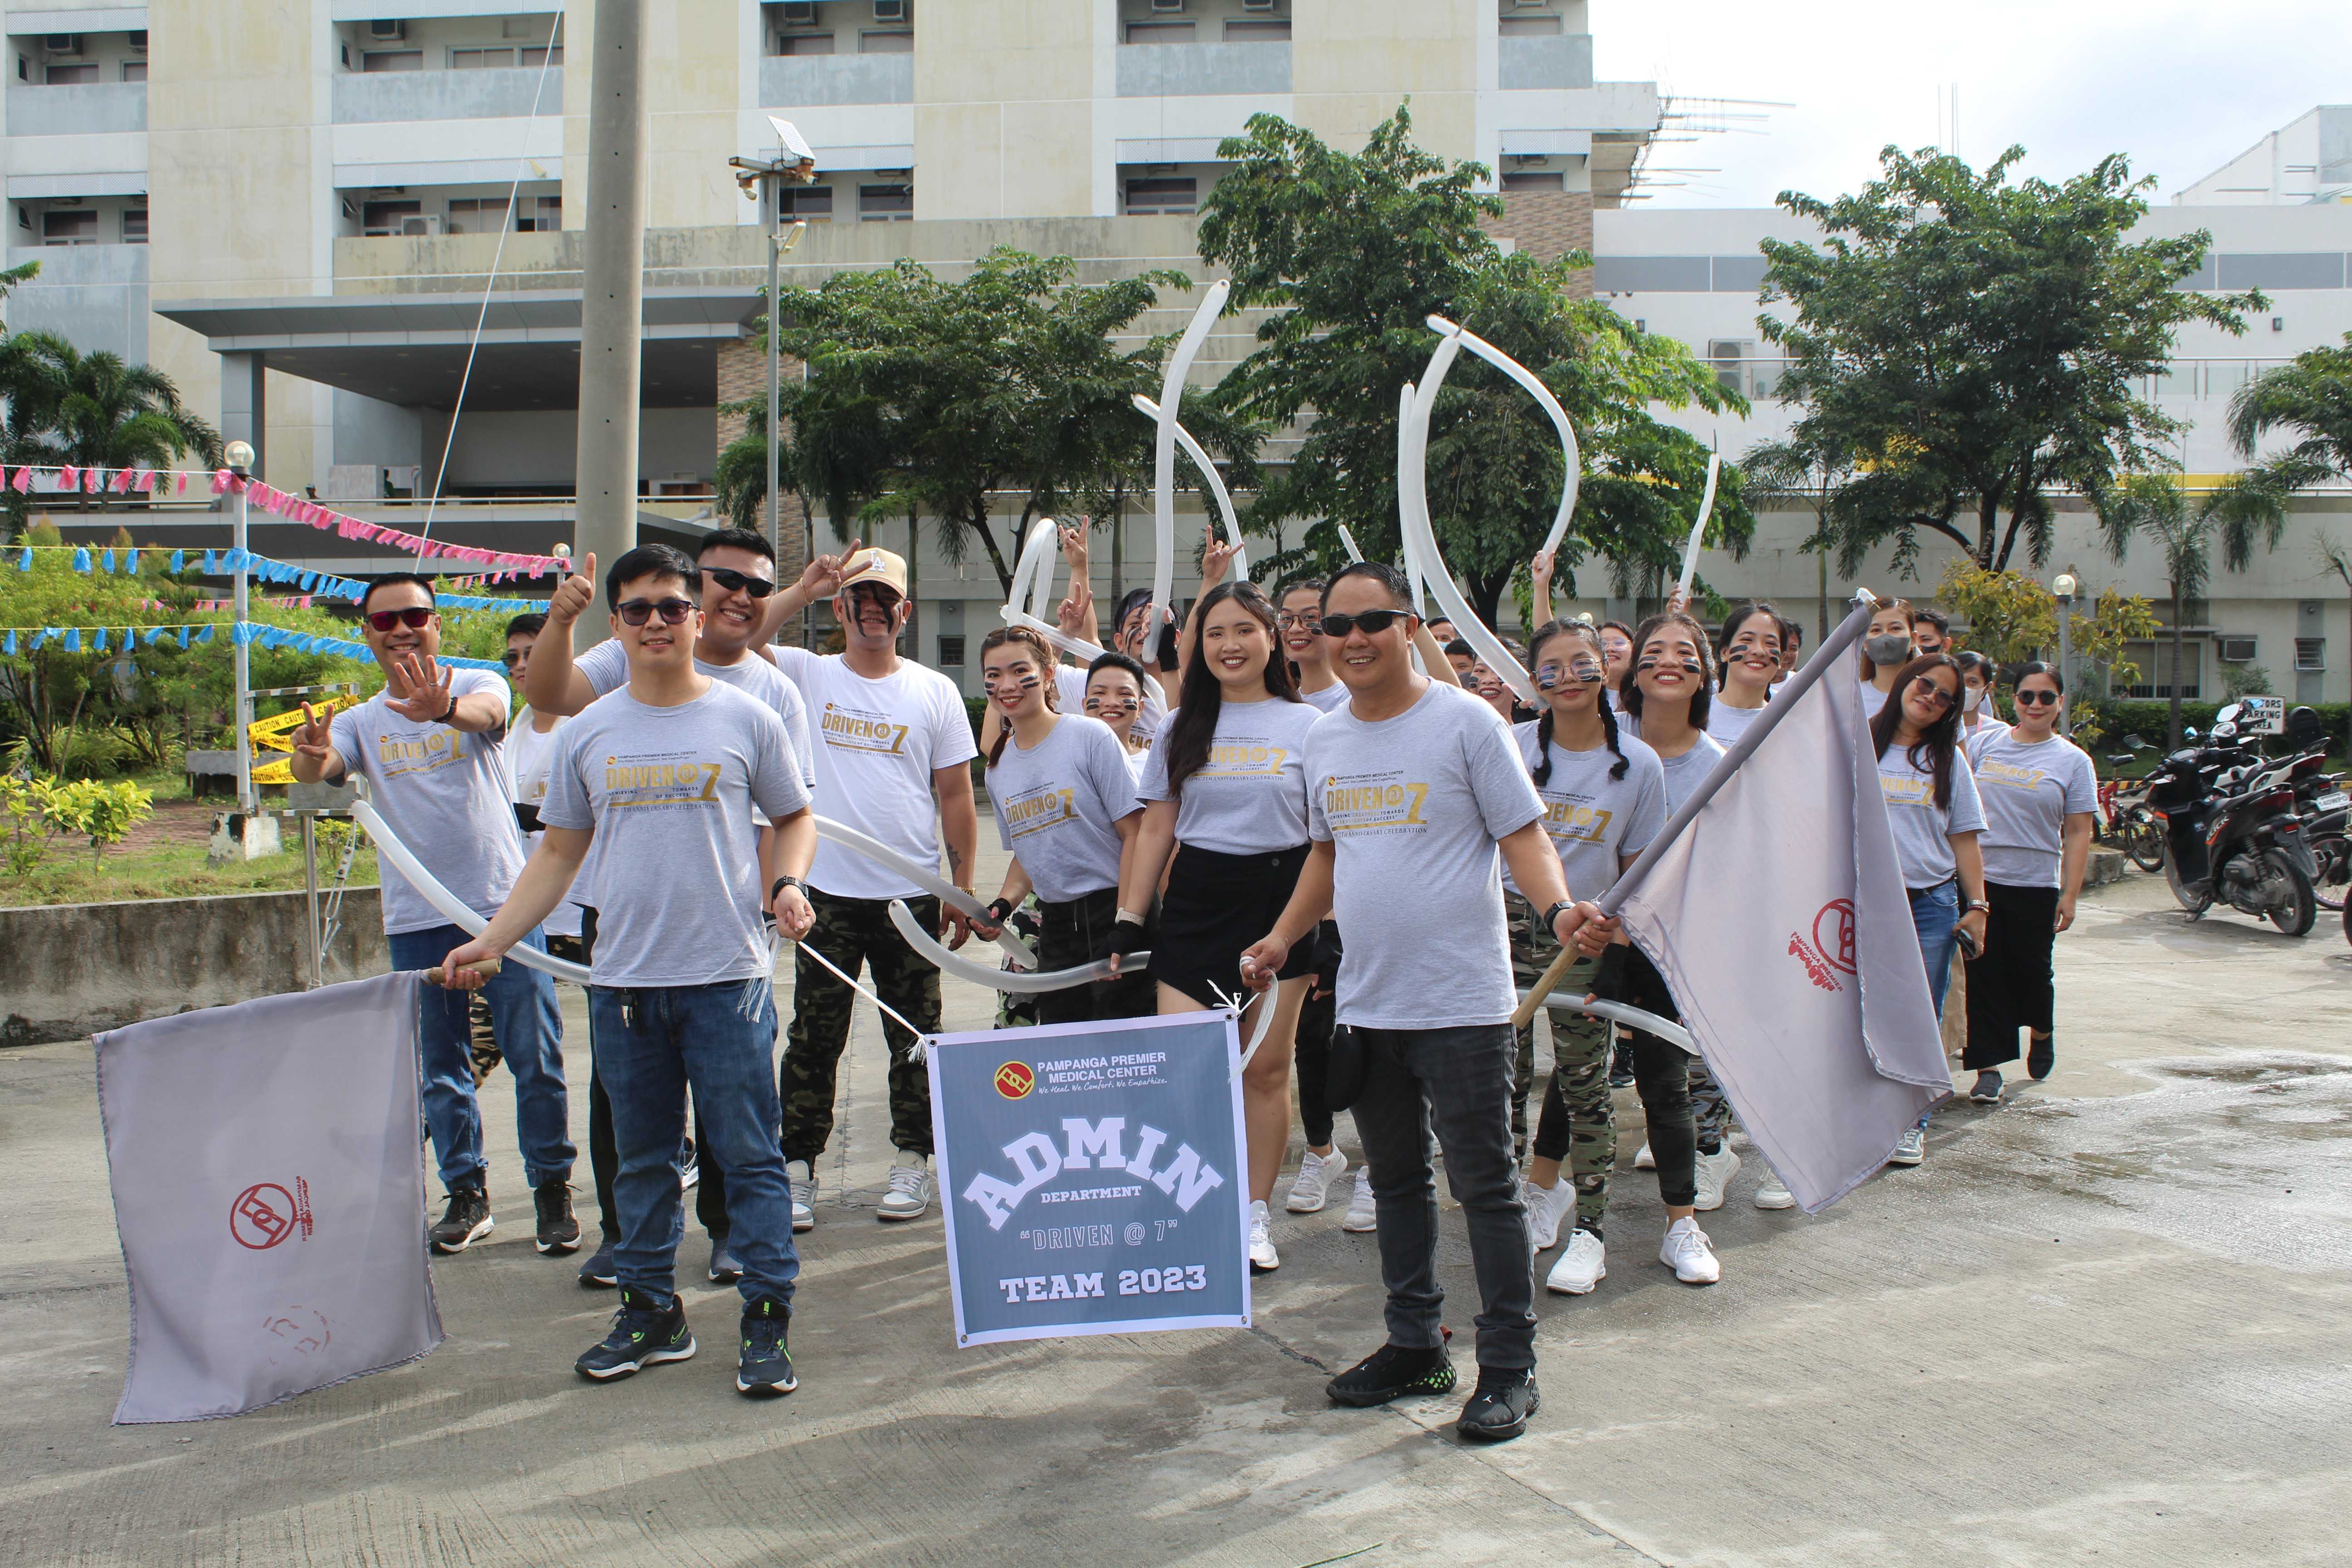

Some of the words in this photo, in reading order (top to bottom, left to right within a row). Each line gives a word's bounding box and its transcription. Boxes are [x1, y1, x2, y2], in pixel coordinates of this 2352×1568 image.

[869, 551, 886, 572] LA
[255, 719, 280, 733] CAUTION
[284, 712, 304, 724] CAUTI
[318, 700, 350, 714] CTION
[1790, 931, 1821, 963] PAMPANGA
[1818, 963, 1843, 992] PREMIER
[1038, 1057, 1108, 1072] PAMPANGA
[1112, 1052, 1166, 1066] PREMIER
[1049, 1070, 1104, 1083] MEDICAL
[1107, 1065, 1157, 1078] CENTER
[1051, 1085, 1069, 1093] Heal.
[1084, 1080, 1114, 1090] Comfort.
[1128, 1077, 1167, 1087] Empathize.
[962, 1117, 1224, 1231] ADMIN
[1041, 1186, 1142, 1203] DEPARTMENT
[1124, 1222, 1145, 1245] @
[1000, 1272, 1105, 1303] TEAM
[1118, 1264, 1207, 1295] 2023
